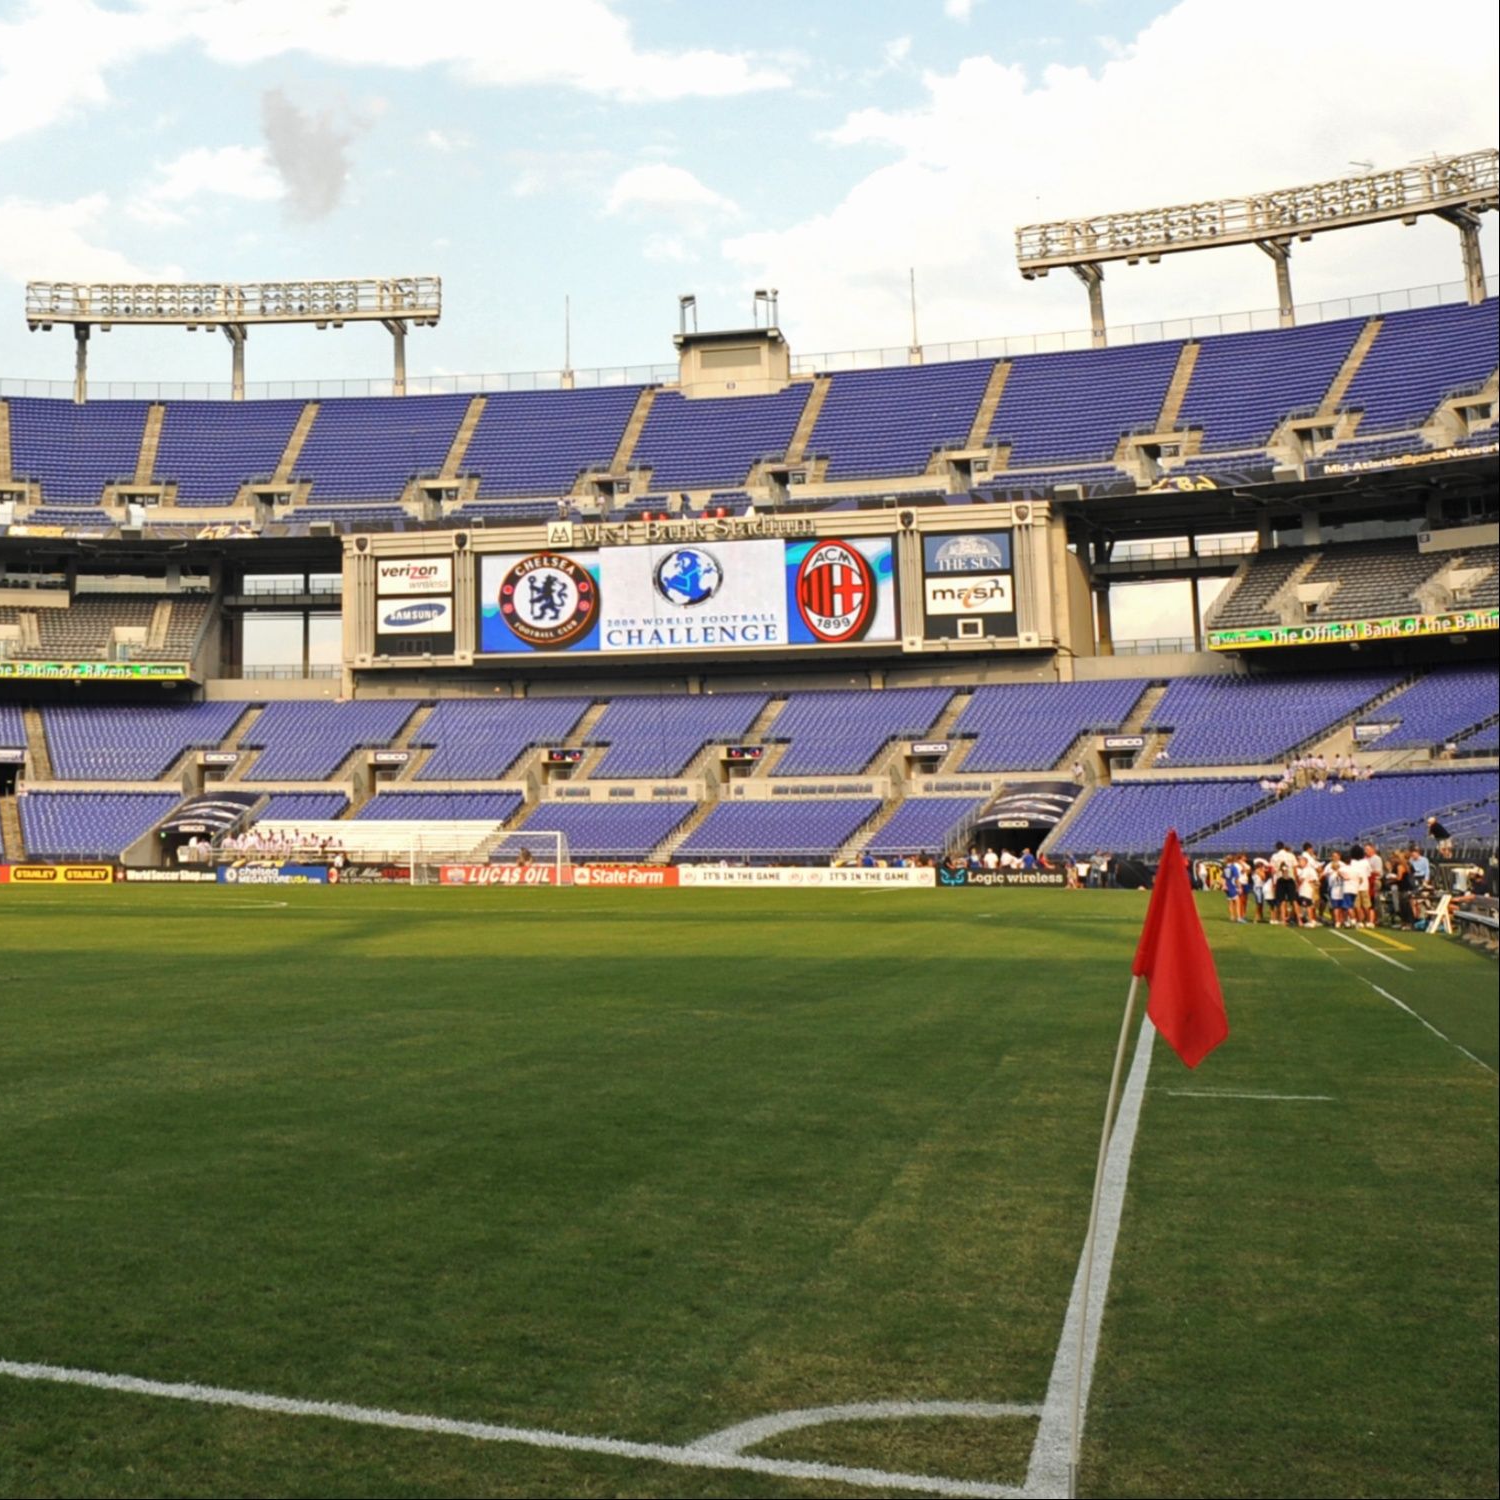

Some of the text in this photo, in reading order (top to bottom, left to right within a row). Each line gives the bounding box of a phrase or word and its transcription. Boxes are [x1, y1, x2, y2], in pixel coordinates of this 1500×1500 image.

[645, 516, 705, 540] Bank
[514, 556, 575, 576] CHELSEA
[811, 548, 852, 568] ACM
[937, 554, 1002, 572] THE SUN
[381, 563, 438, 579] verizon
[390, 609, 439, 621] SAMSUNG
[642, 616, 694, 625] WORLD
[701, 613, 776, 624] FOOTBALL
[816, 618, 851, 630] 1899
[1270, 630, 1299, 645] The
[1301, 623, 1359, 643] Official
[1363, 620, 1401, 637] Bank
[1404, 616, 1421, 634] of
[1424, 615, 1452, 631] the
[607, 624, 778, 646] CHALLENGE
[16, 665, 81, 678] Baltimore
[85, 665, 133, 678] Ravens
[16, 870, 55, 879] STANLEY
[66, 870, 106, 879] STANLEY
[469, 867, 521, 883] LUCAS
[524, 867, 550, 882] OIL
[967, 871, 1063, 885] Logic wireless
